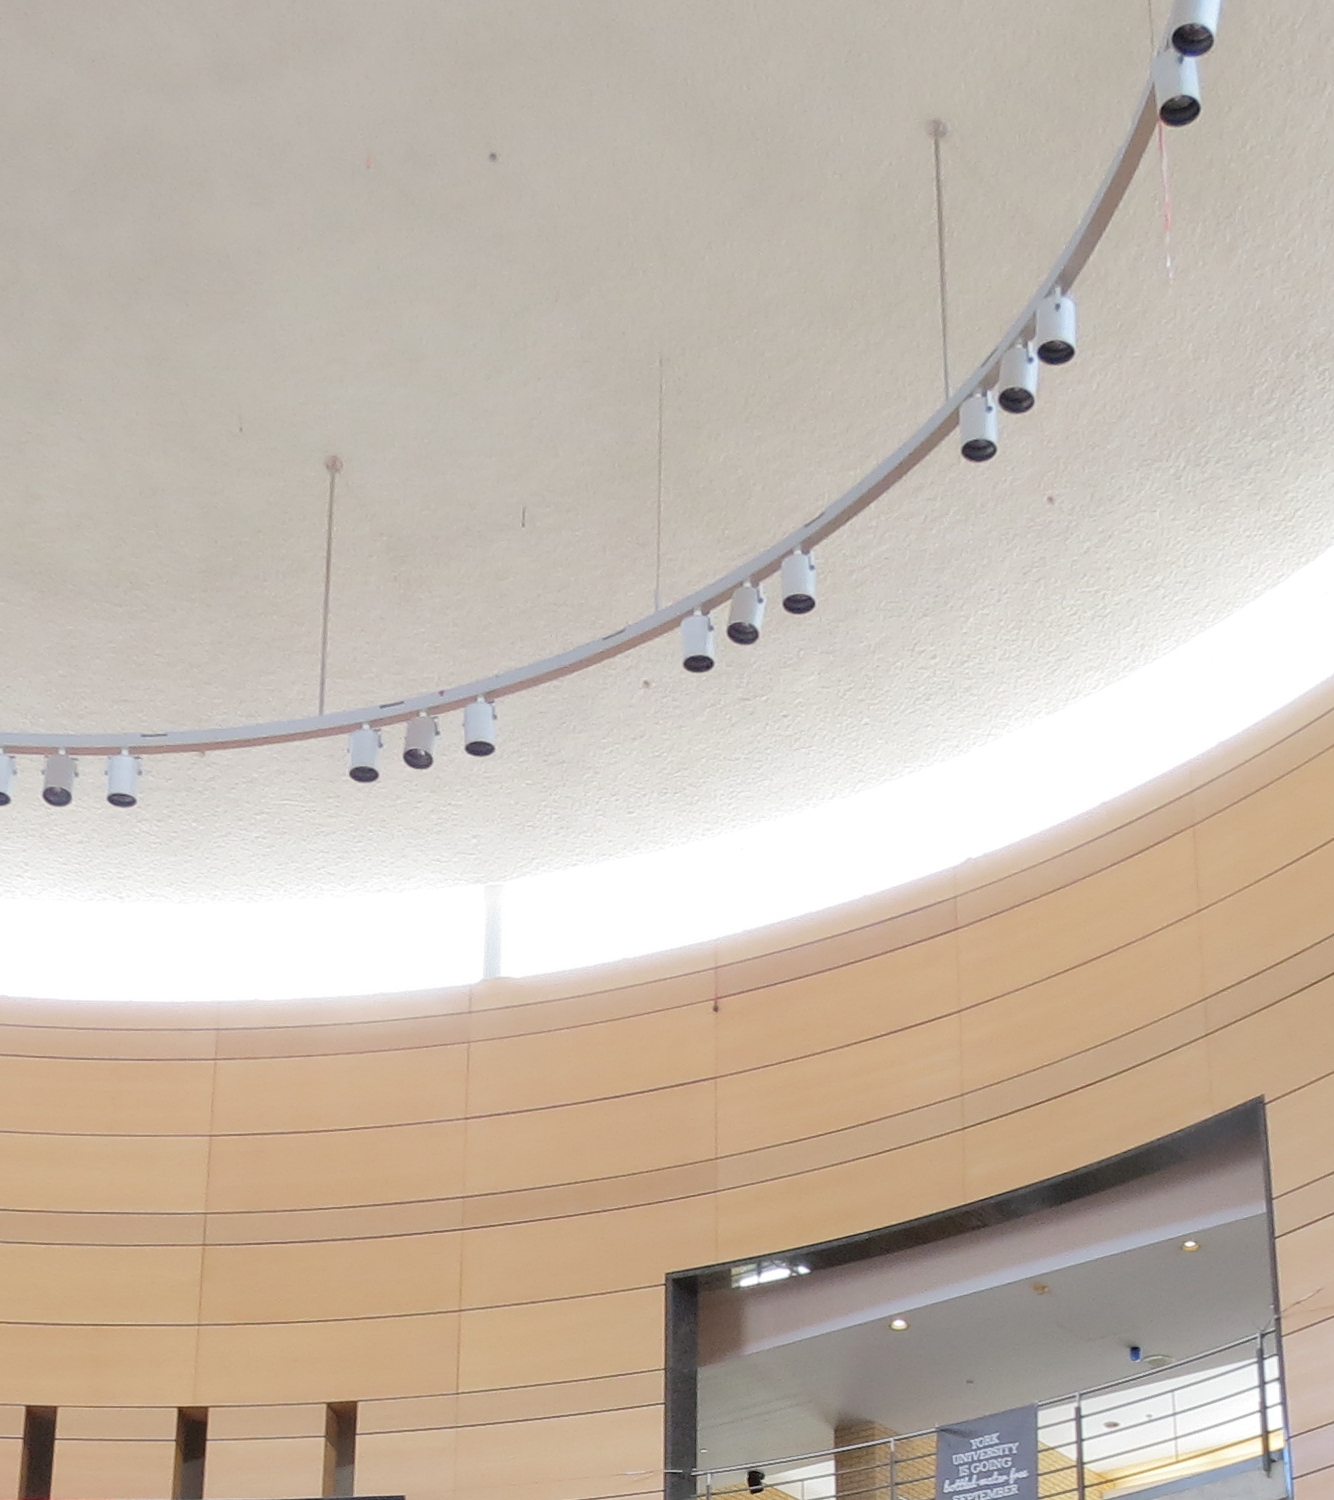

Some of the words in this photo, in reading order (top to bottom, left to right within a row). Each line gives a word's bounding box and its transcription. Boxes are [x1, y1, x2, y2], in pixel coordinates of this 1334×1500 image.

[970, 1432, 1000, 1449] YORK
[952, 1442, 1019, 1465] UNIVERSITY
[959, 1465, 969, 1476] IS
[971, 1457, 1012, 1473] GOING
